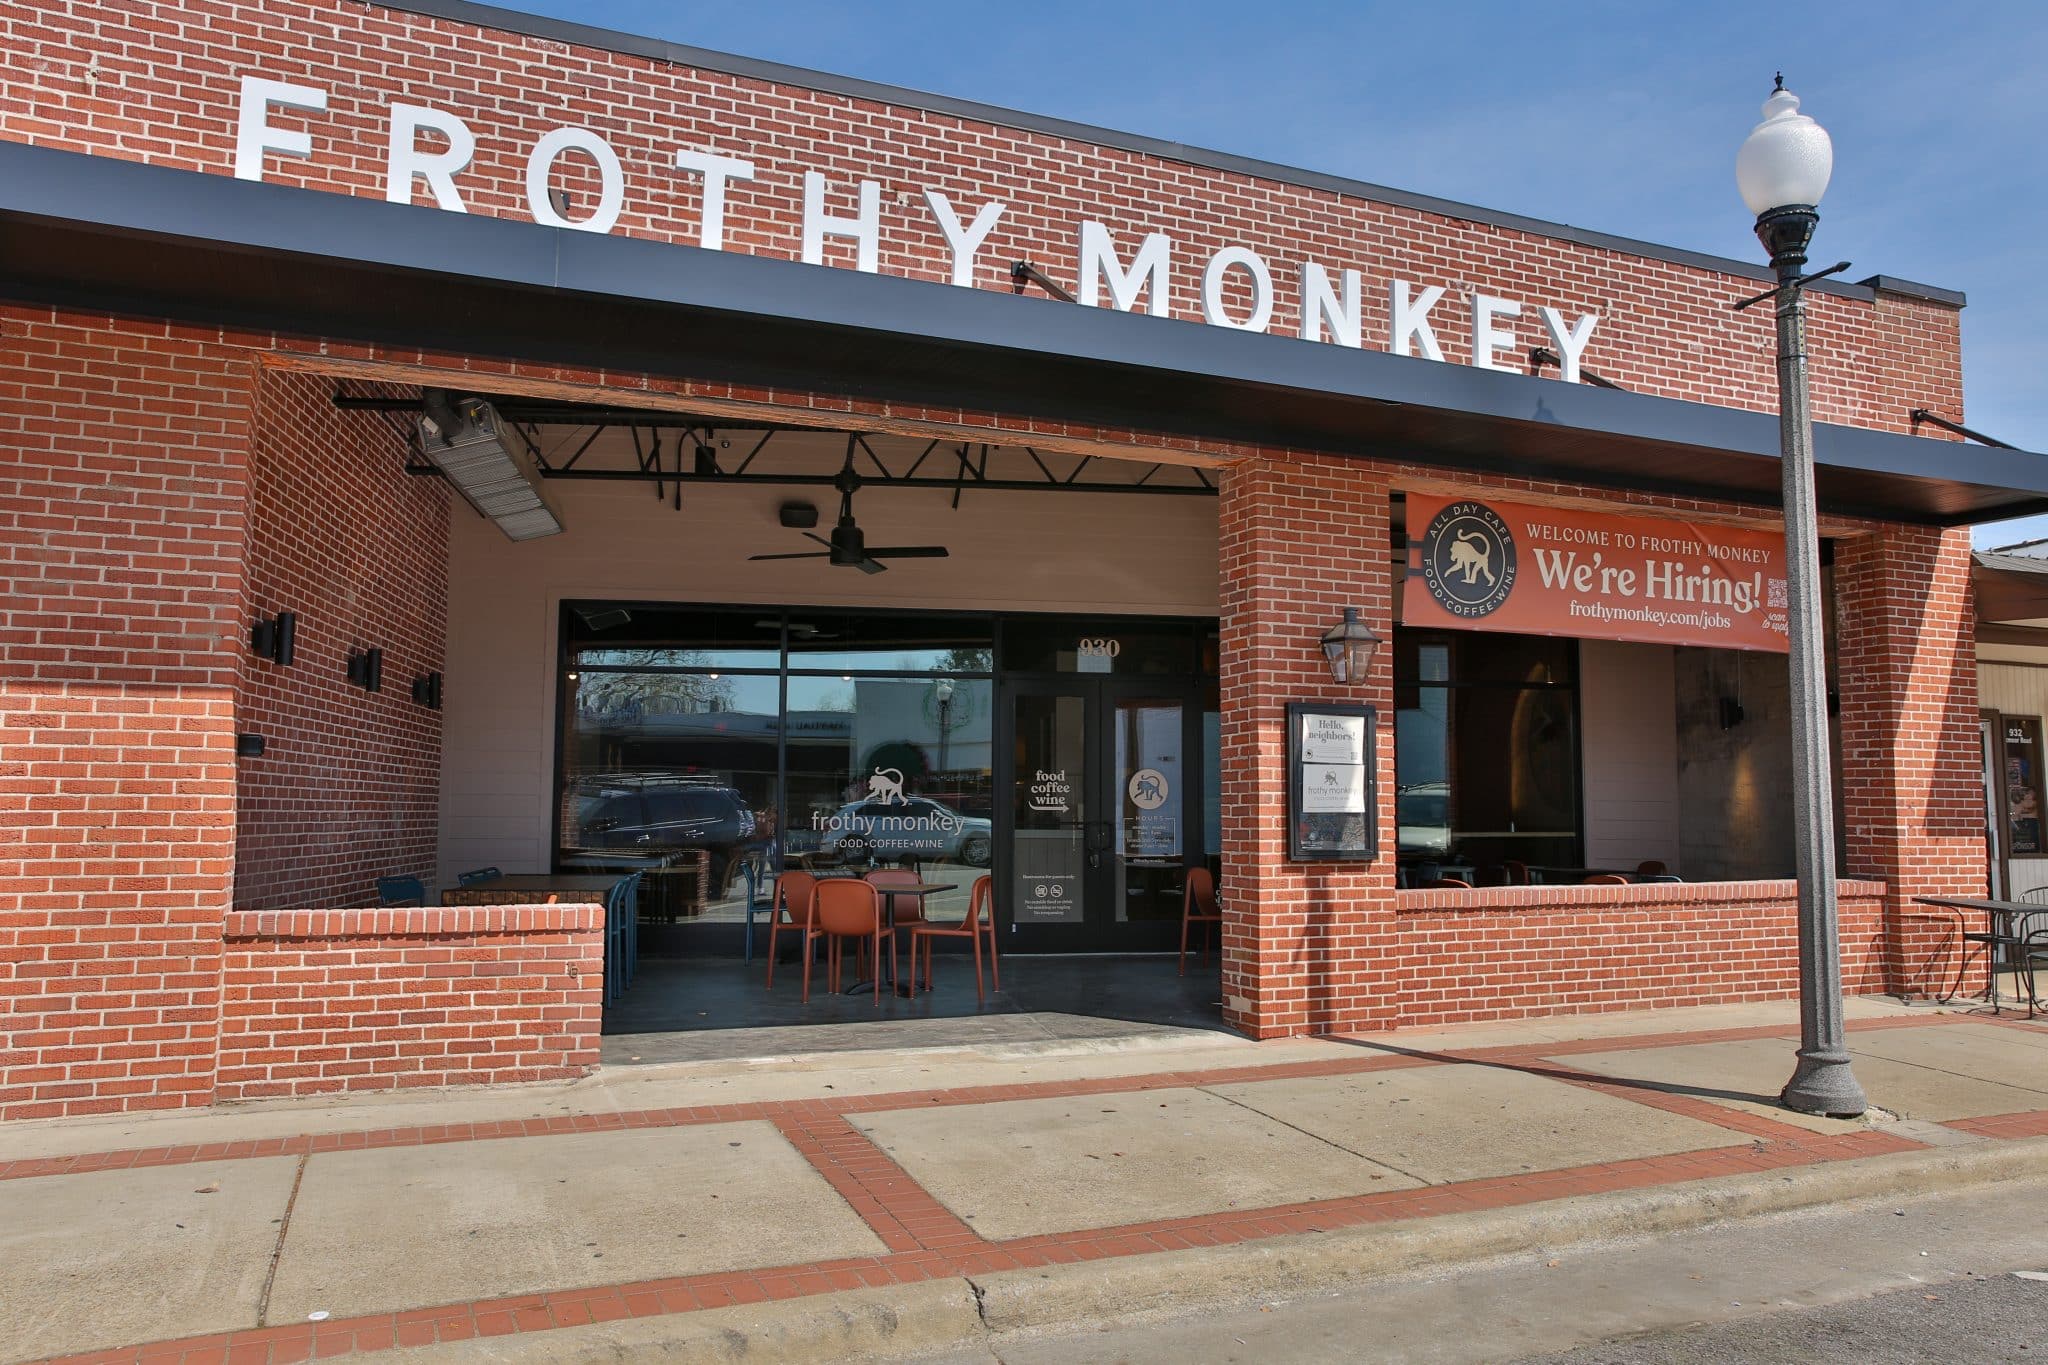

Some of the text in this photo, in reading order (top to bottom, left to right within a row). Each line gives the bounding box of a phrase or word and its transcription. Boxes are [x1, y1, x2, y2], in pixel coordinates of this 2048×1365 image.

[234, 76, 1598, 384] FROTHY MONKEY
[1430, 504, 1512, 545] ALL DAY CAFE
[1526, 523, 1771, 564] WELCOME TO FROTHY MONKEY
[1424, 558, 1515, 616] FOOD COFFEE WINE
[1533, 548, 1761, 613] We're Hiring!
[1569, 600, 1731, 628] frothymonkey.com/jobs
[1080, 638, 1120, 657] 930
[1319, 719, 1344, 730] Hello,
[2008, 728, 2023, 737] 932
[1308, 730, 1355, 743] neighbors!
[1036, 769, 1065, 781] food
[1031, 781, 1071, 793] coffee
[1035, 793, 1066, 805] wine
[811, 810, 966, 836] frothy monkey
